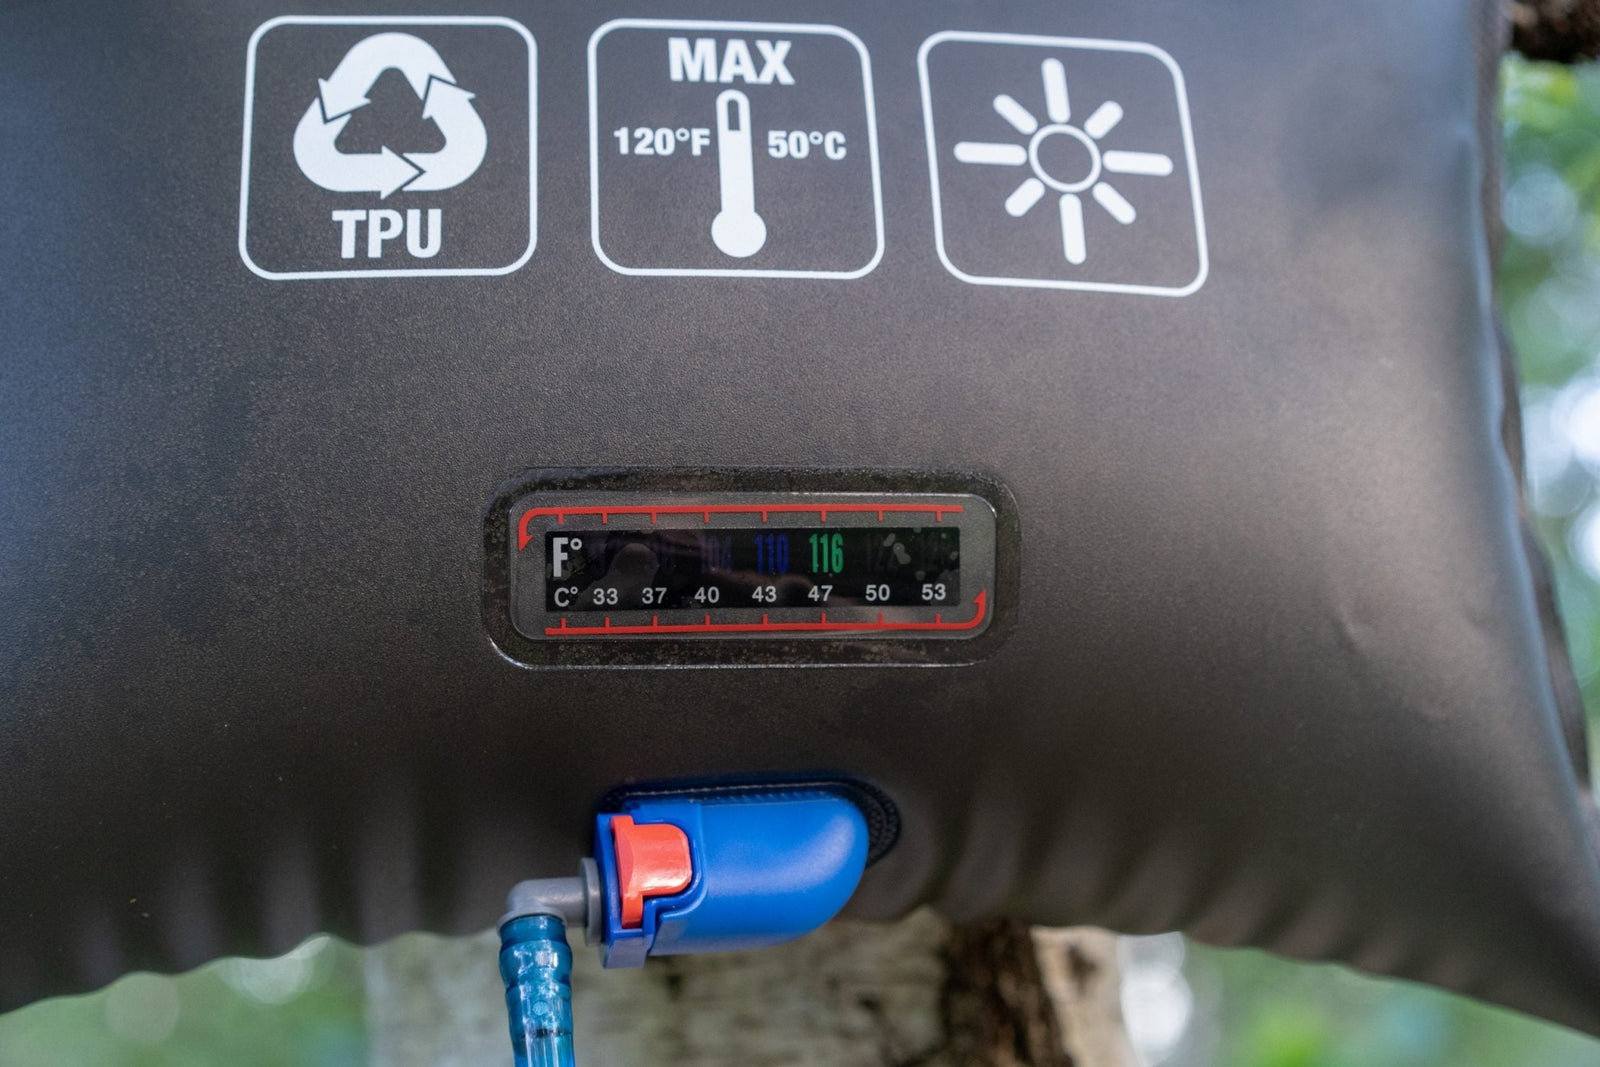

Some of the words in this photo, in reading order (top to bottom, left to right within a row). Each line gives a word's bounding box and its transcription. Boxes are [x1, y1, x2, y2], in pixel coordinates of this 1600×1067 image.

[668, 37, 796, 86] MAX
[613, 127, 711, 156] 120°F
[767, 130, 847, 161] 50°C
[331, 208, 443, 259] TPU
[754, 534, 790, 574] 110
[809, 533, 844, 573] 116
[593, 587, 619, 605] 33
[642, 587, 667, 604] 37
[694, 586, 720, 603] 40
[752, 585, 777, 603] 43
[808, 585, 833, 602] 47
[865, 584, 890, 601] 50
[921, 583, 947, 601] 53
